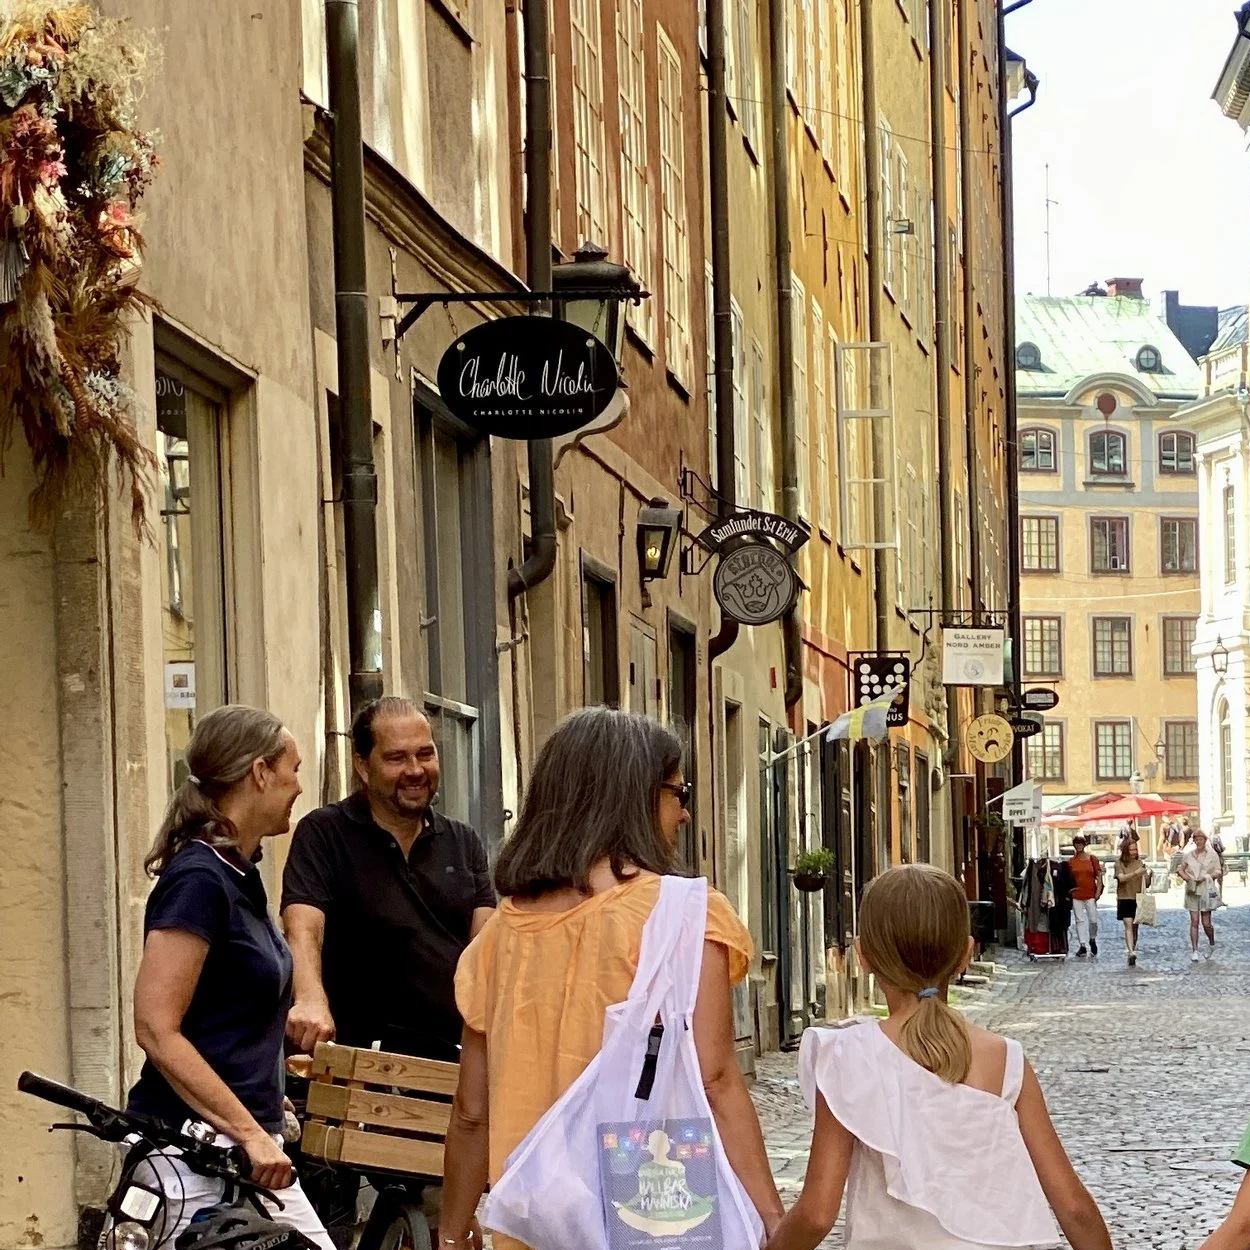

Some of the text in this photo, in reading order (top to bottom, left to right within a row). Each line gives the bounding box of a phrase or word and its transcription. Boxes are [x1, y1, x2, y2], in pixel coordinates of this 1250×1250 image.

[459, 349, 605, 400] Charlotte Nicolin
[473, 407, 583, 417] CHARLOTTE NICOLIN
[710, 515, 762, 543] Samfundet
[775, 520, 799, 545] Erik
